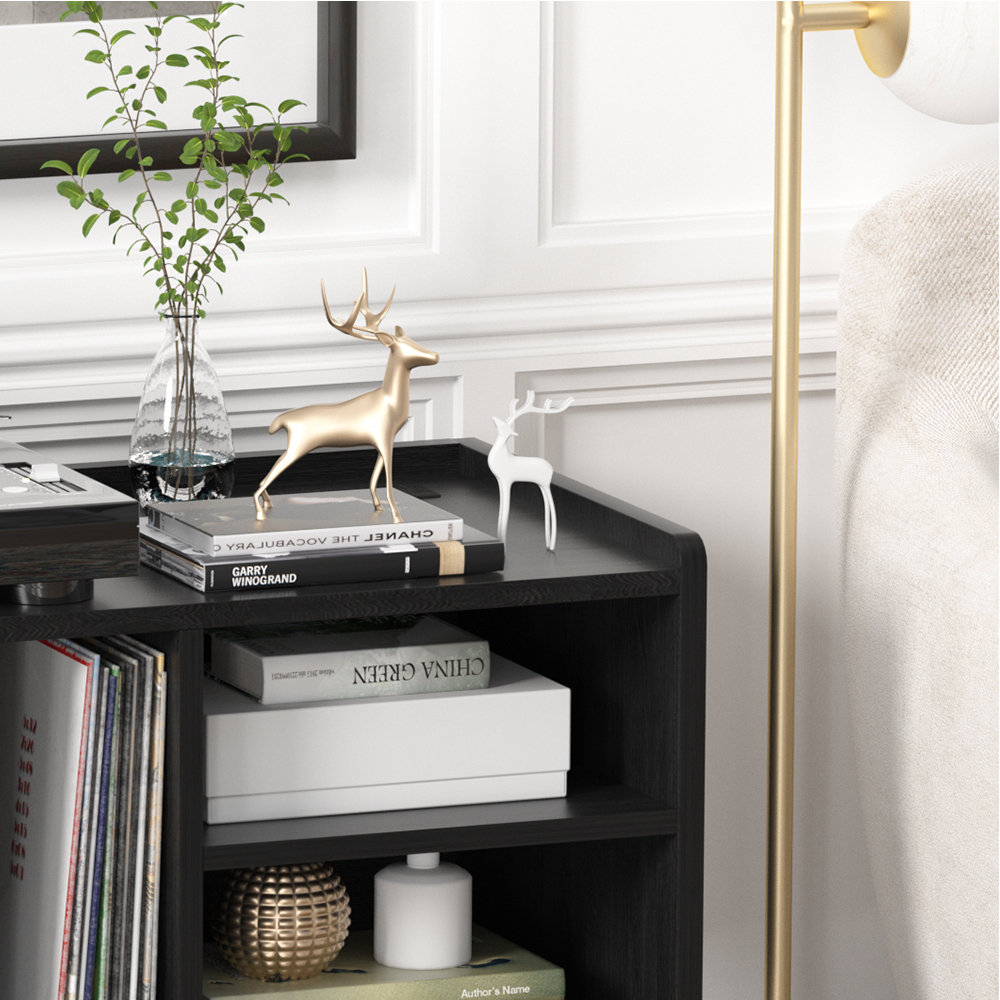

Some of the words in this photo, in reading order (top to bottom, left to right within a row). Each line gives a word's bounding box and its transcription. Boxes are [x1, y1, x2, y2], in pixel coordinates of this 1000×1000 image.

[231, 565, 268, 577] GARRY
[231, 573, 298, 588] WINOGRAND
[352, 662, 416, 685] GREEN
[421, 657, 485, 679] CHINA
[461, 986, 500, 999] Author's
[502, 985, 531, 996] Name
